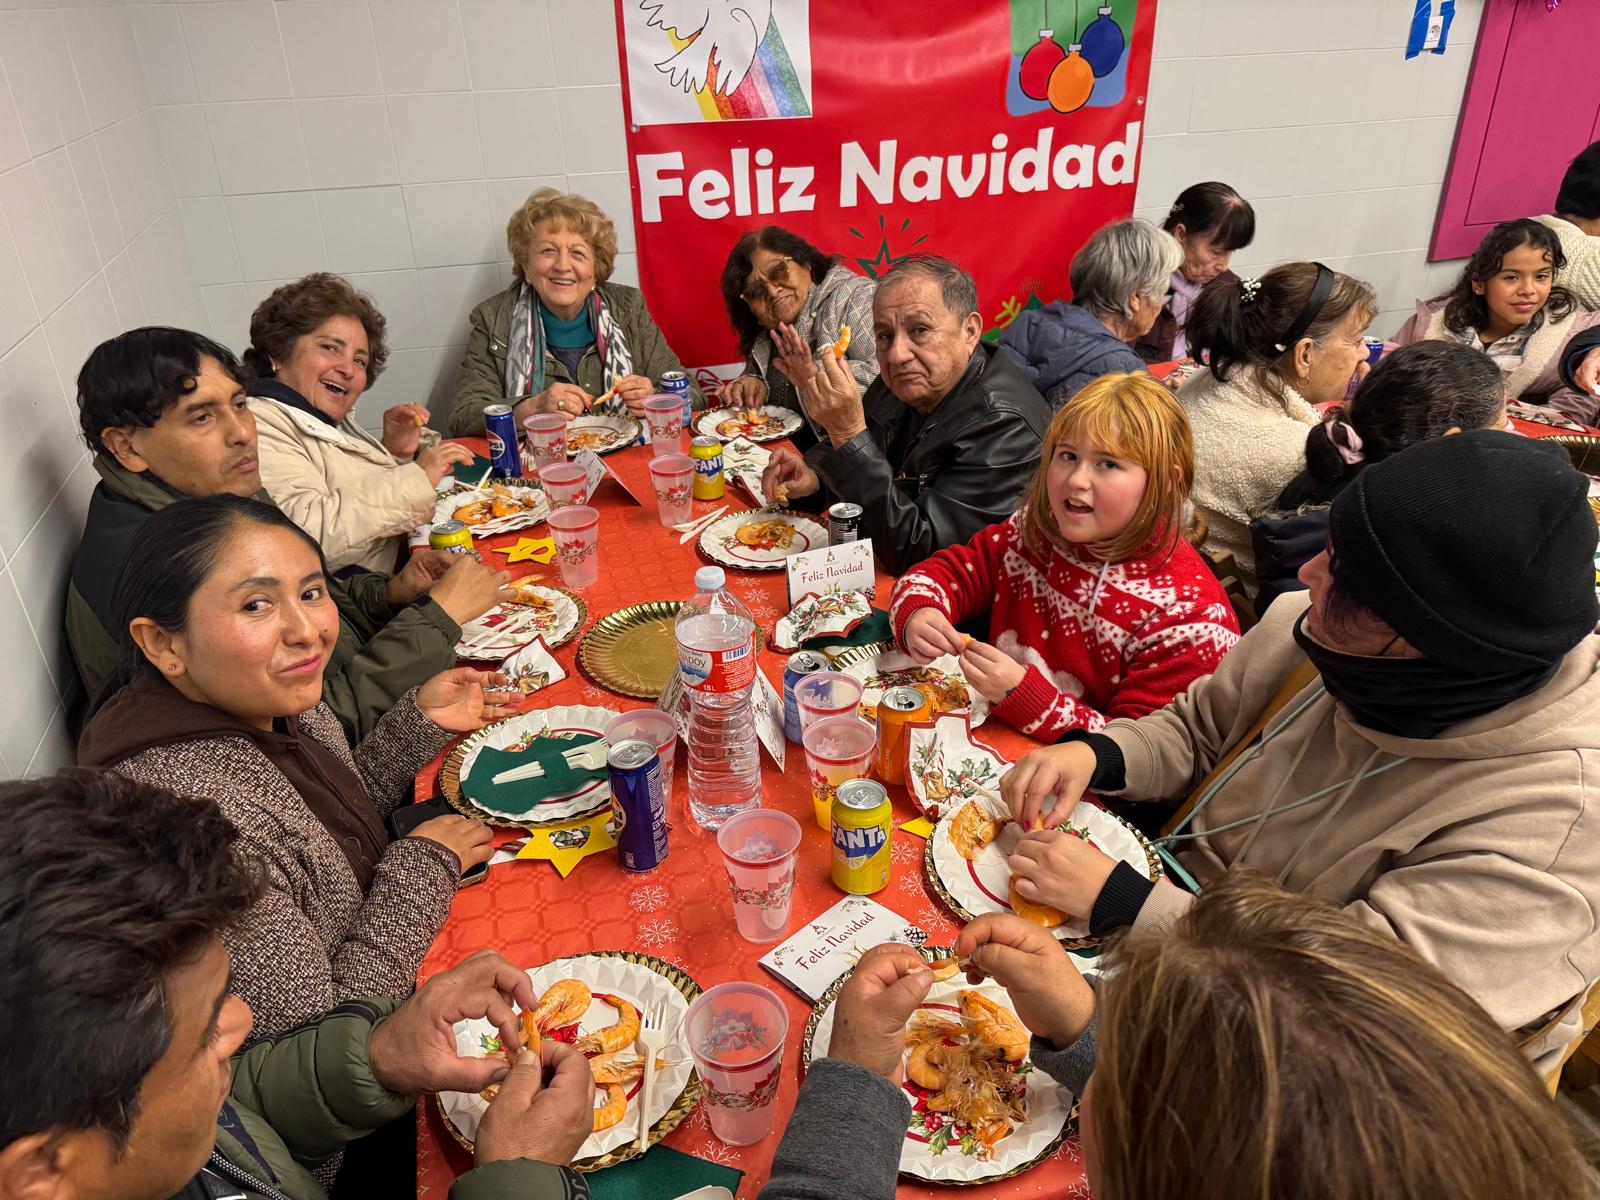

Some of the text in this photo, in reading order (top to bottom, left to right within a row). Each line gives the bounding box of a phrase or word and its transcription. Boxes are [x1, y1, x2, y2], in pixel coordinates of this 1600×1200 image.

[636, 120, 1142, 223] Feliz Navidad
[695, 454, 723, 472] FANT
[800, 570, 825, 584] Feliz
[826, 560, 864, 578] Navidad
[831, 819, 887, 849] FANTA
[795, 944, 831, 971] Feliz
[824, 911, 876, 948] Navidad
